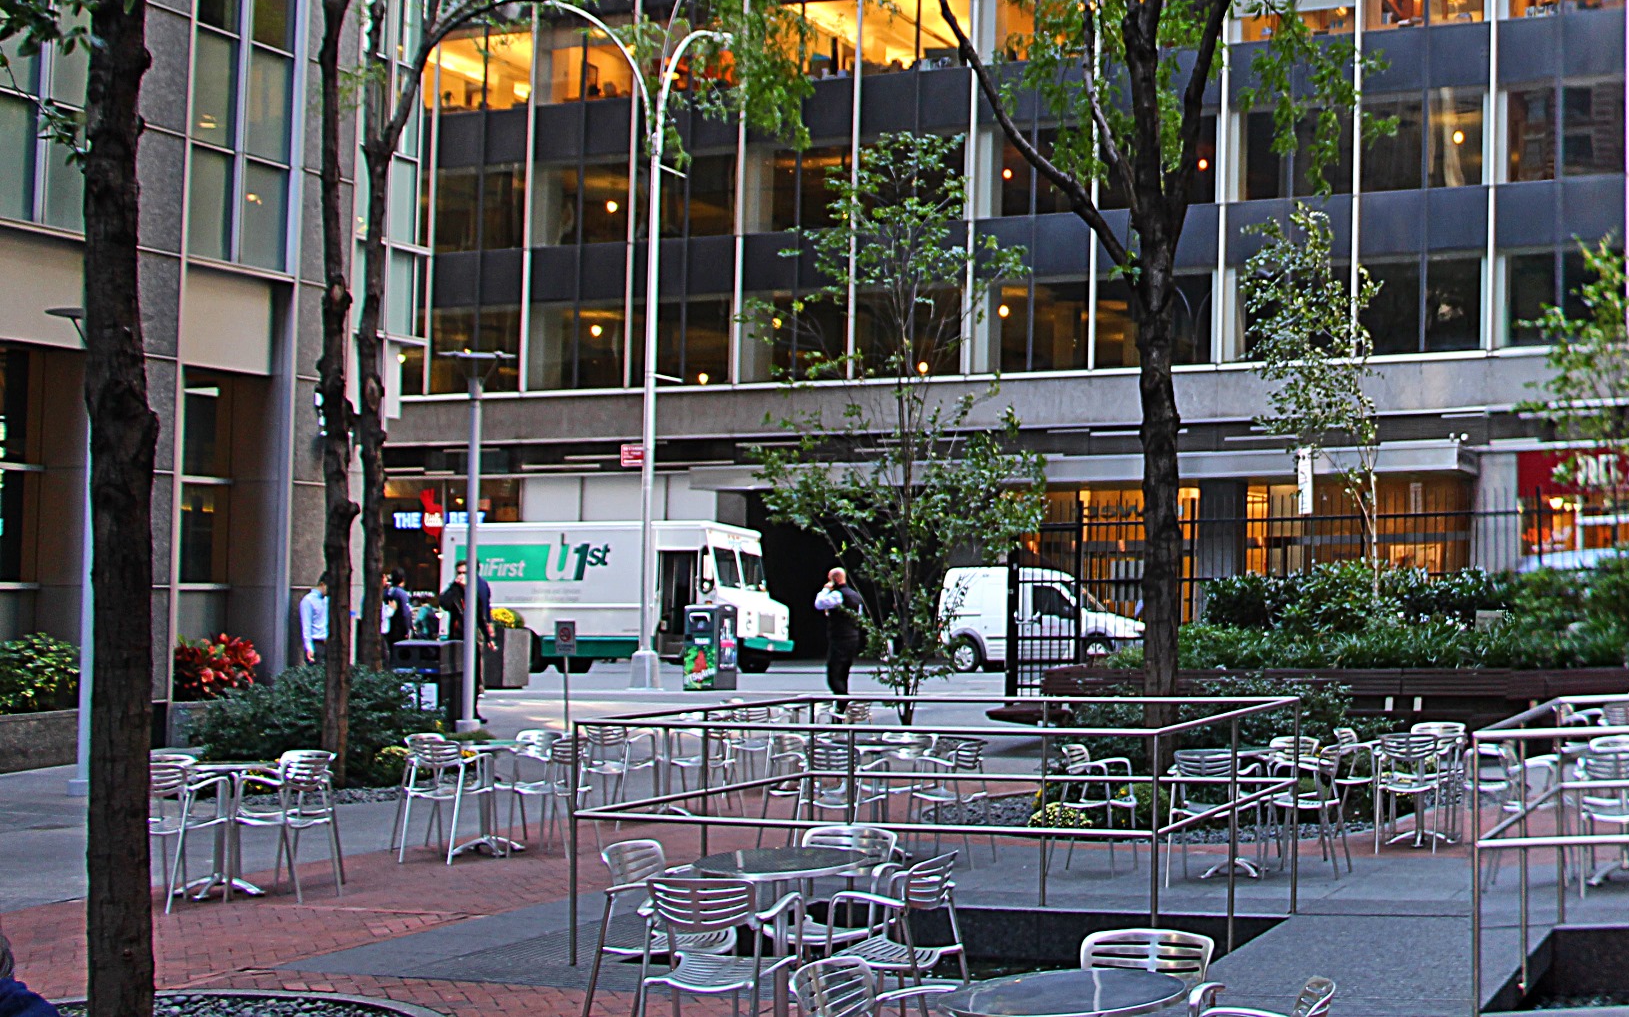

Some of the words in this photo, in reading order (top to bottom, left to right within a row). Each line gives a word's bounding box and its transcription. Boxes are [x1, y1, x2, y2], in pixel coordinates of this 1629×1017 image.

[394, 511, 422, 529] THE
[448, 511, 485, 524] BET
[478, 557, 526, 578] niFirst
